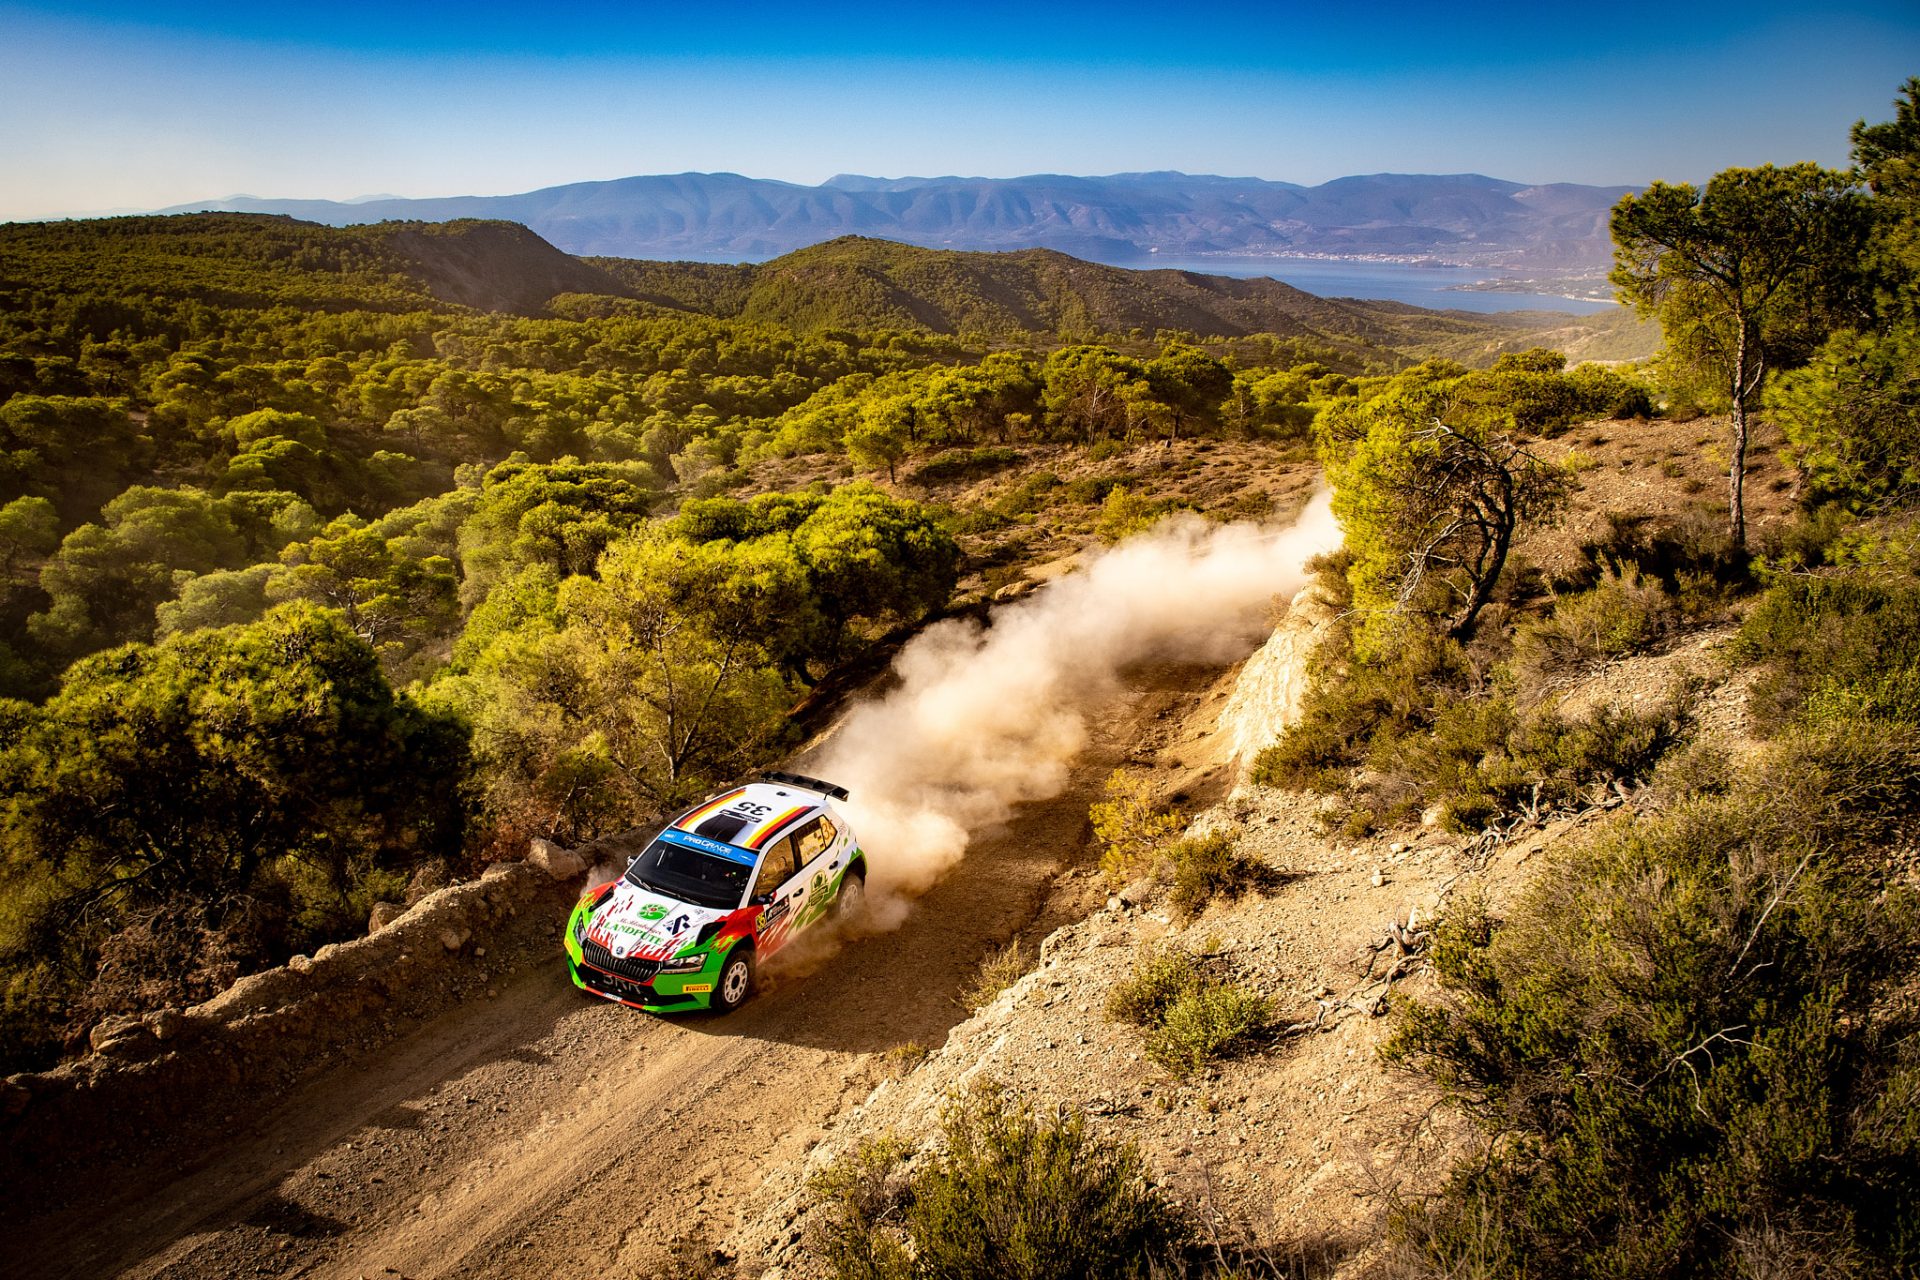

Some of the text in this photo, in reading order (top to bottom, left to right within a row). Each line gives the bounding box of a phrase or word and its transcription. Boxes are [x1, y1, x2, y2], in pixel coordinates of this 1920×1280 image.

[733, 801, 772, 816] 35
[604, 922, 664, 946] LANDPUTE
[685, 984, 709, 992] PIRELLI
